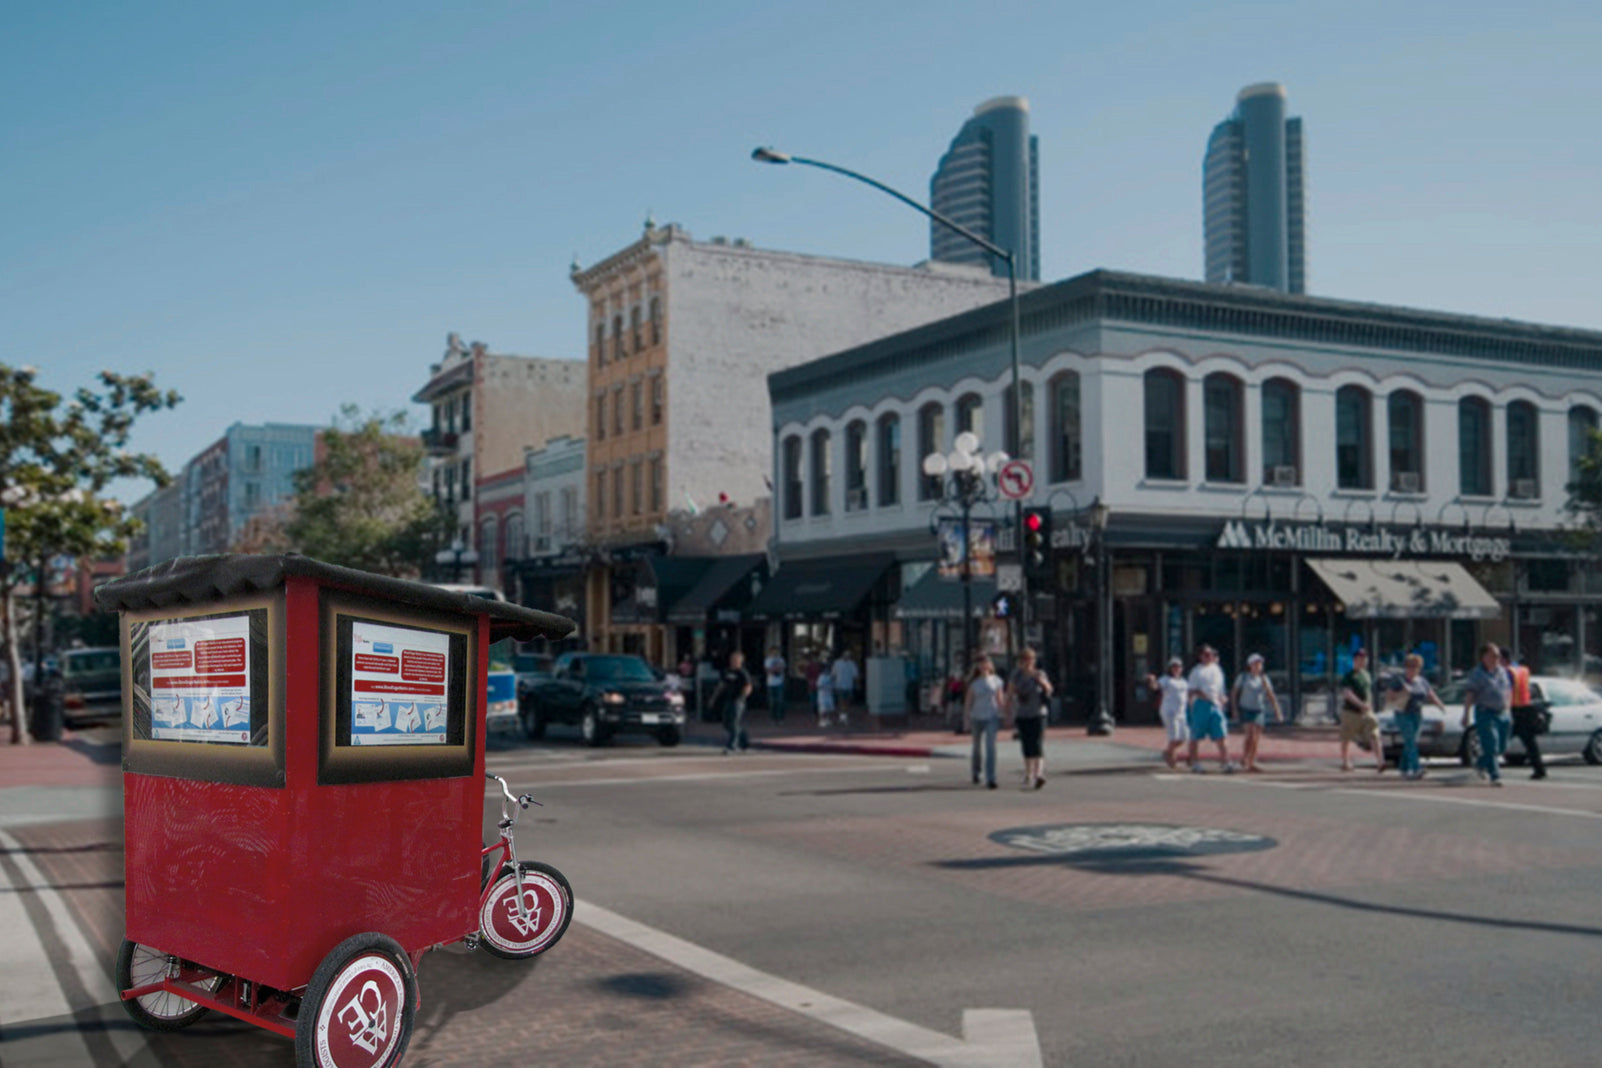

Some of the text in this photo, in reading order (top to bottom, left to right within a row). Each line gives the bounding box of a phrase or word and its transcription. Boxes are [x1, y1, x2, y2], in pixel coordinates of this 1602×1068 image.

[1051, 524, 1091, 553] ealty
[1255, 524, 1342, 550] McMillin
[1346, 527, 1406, 558] Realty
[1410, 530, 1428, 552] &
[1430, 531, 1511, 563] Mortgage
